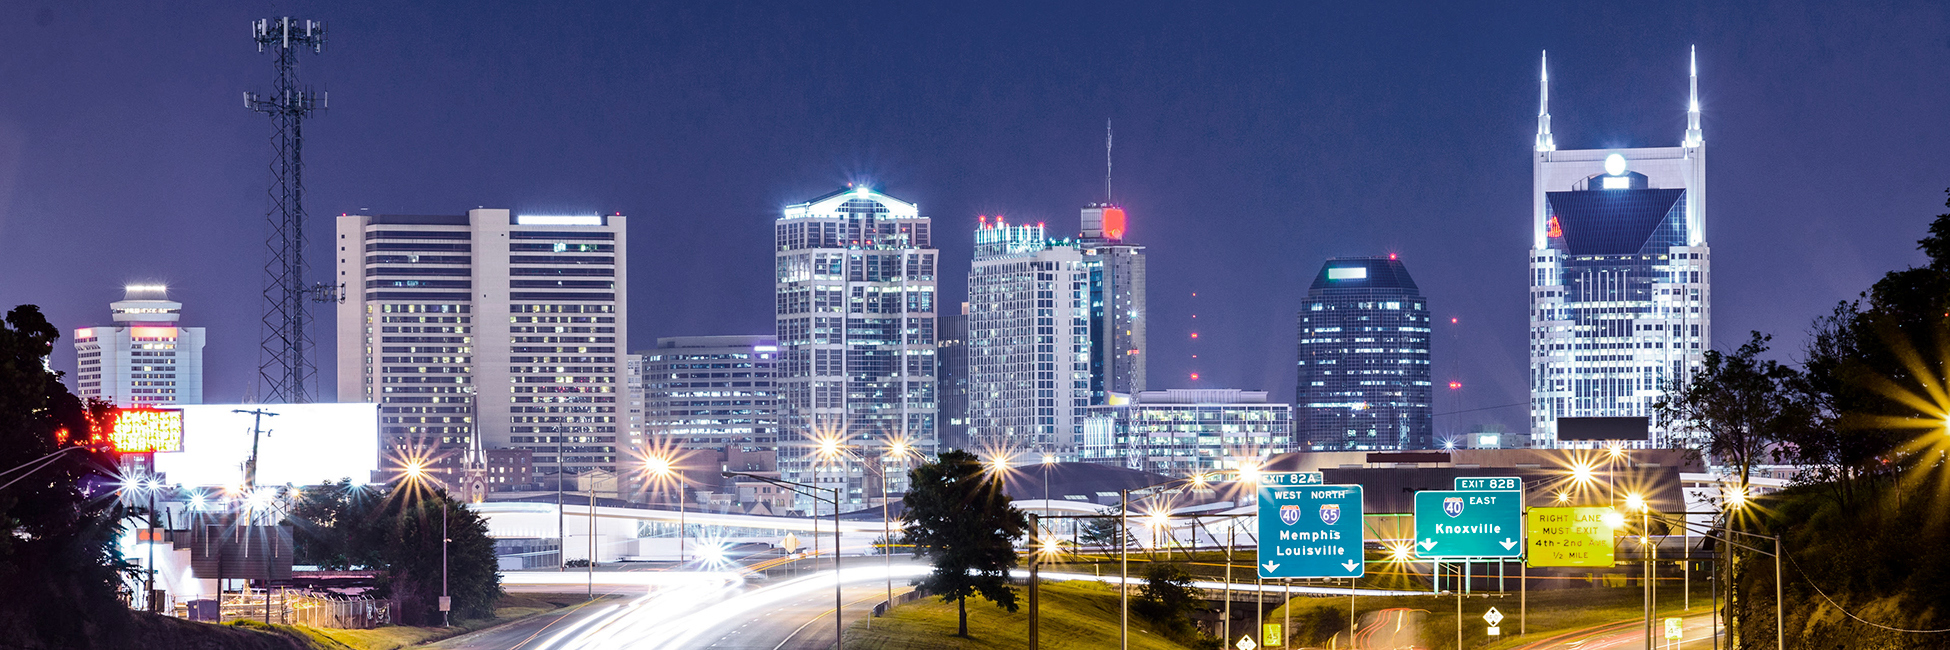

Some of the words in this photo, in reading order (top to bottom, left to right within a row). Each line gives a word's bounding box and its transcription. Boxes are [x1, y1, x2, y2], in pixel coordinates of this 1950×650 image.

[1262, 474, 1285, 483] EXIT
[1290, 474, 1316, 484] 82A
[1461, 480, 1484, 488] EXIT
[1489, 479, 1515, 489] 82B
[1274, 491, 1302, 499] WEST
[1311, 491, 1345, 499] NORTH
[1469, 496, 1496, 505] EAST
[1446, 502, 1461, 513] 40
[1283, 510, 1298, 521] 40
[1323, 509, 1337, 521] 65
[1435, 523, 1501, 534] Knoxville
[1542, 527, 1570, 535] MUST
[1576, 527, 1598, 535] EXIT
[1279, 530, 1341, 542] Memphis
[1276, 545, 1345, 555] Louisville
